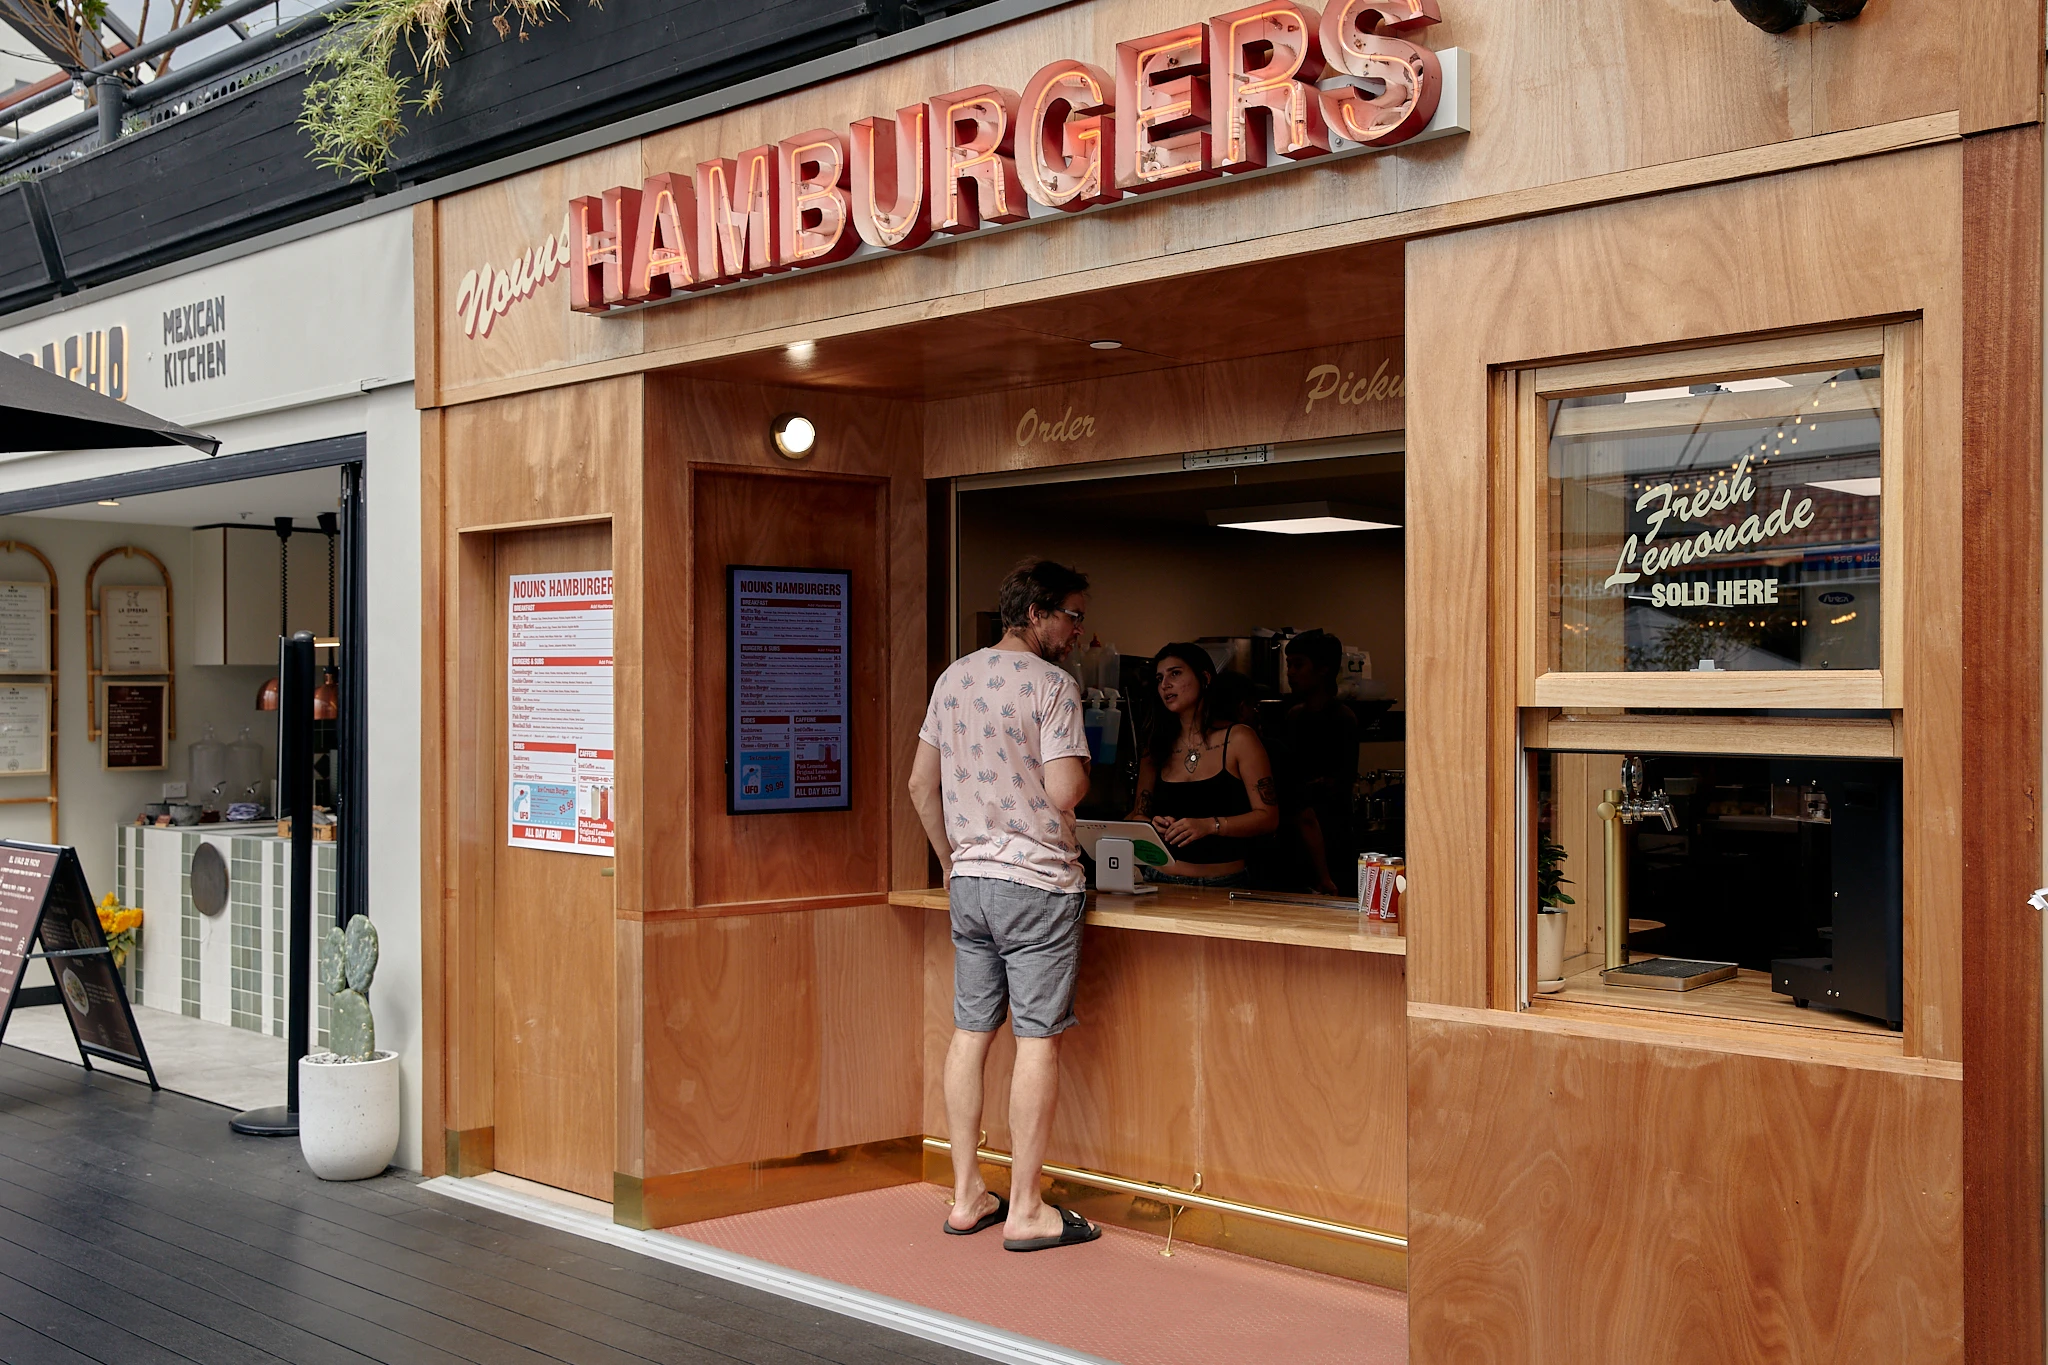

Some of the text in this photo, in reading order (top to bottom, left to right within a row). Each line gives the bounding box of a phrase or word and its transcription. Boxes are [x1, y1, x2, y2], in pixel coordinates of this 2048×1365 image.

[457, 0, 1443, 339] Nouns HAMBURGERS
[163, 295, 226, 346] MEXICAN
[164, 339, 226, 388] KITCHEN
[1015, 406, 1096, 448] Order
[1635, 454, 1757, 546] Fresh
[1604, 488, 1816, 590] Lemonade
[513, 580, 546, 599] NOUNS
[741, 580, 841, 595] NOUNS HAMBURGERS
[1651, 581, 1710, 608] SOLD
[1716, 578, 1779, 605] HERE
[513, 604, 536, 612] BREAKFAST
[744, 785, 759, 794] UFO
[765, 780, 784, 793] $9.99
[796, 786, 840, 796] ALL DAY MENU
[558, 799, 574, 815] $9.99
[519, 811, 529, 820] UFO
[525, 827, 562, 840] ALL DAY MENU
[590, 821, 608, 830] Lemonade
